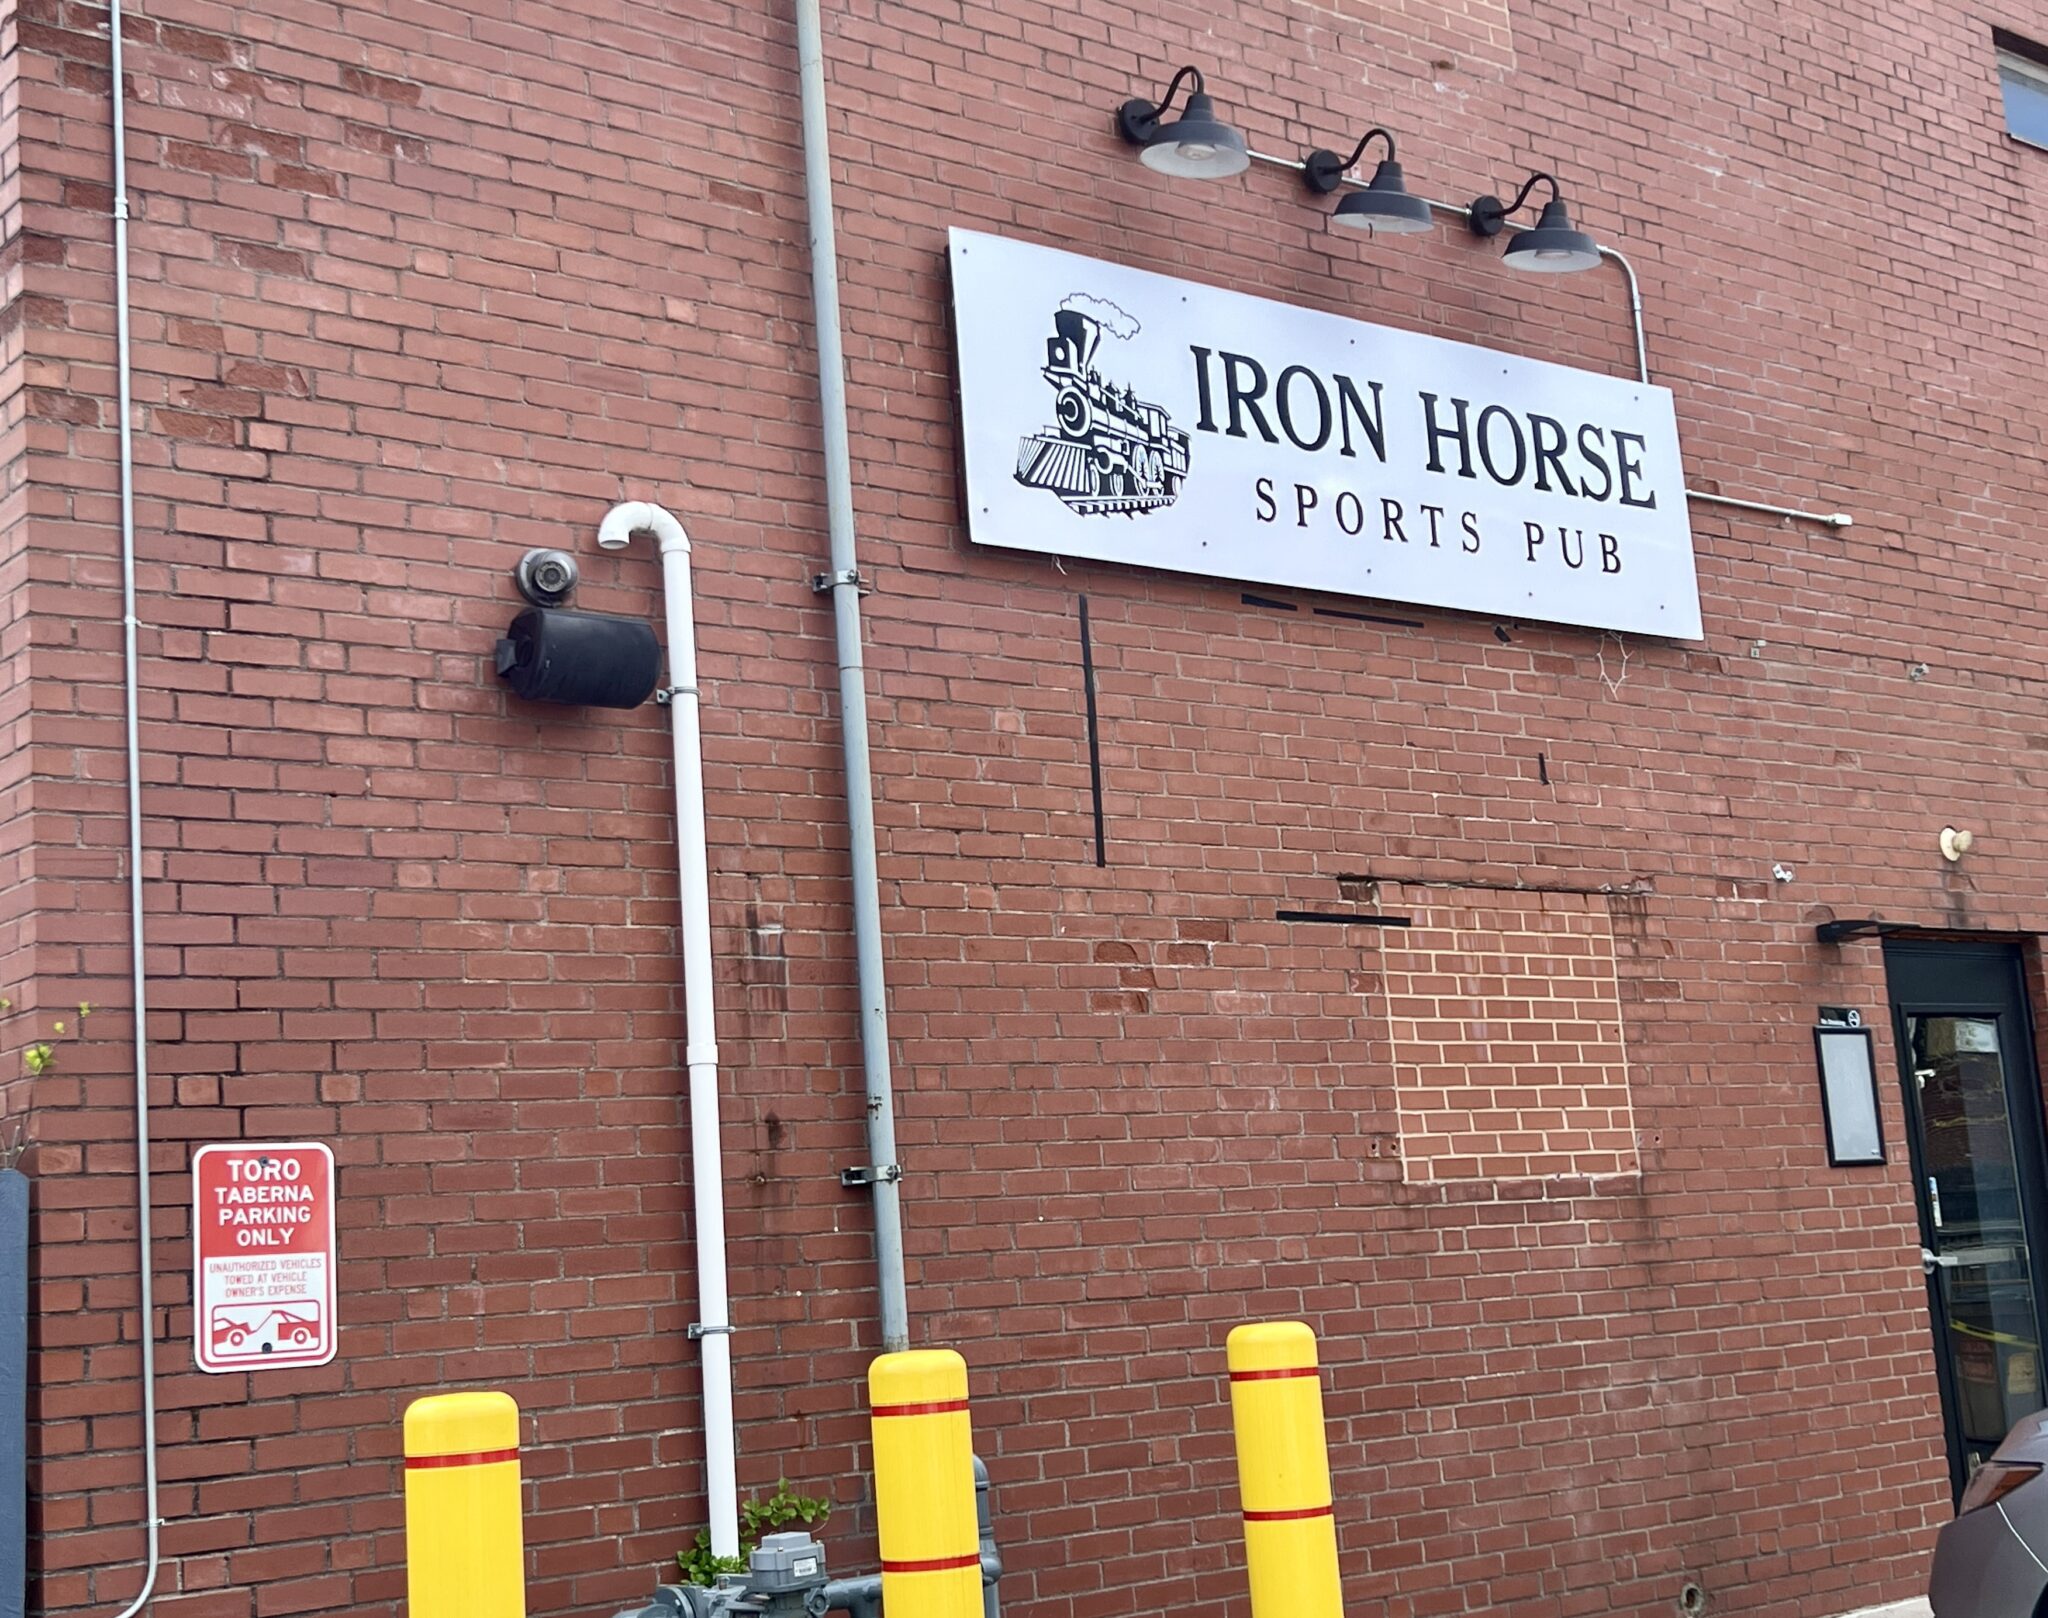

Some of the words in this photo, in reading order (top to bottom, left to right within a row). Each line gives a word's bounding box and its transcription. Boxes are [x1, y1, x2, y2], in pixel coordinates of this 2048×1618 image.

[1190, 344, 1387, 464] IRON
[1418, 391, 1657, 510] HORSE
[1255, 477, 1481, 554] SPORTS
[1523, 521, 1622, 574] PUB
[226, 1158, 301, 1182] TORO
[214, 1185, 314, 1205] TABERNA
[218, 1205, 311, 1226] PARKING
[236, 1227, 295, 1247] ONLY
[209, 1260, 277, 1274] UNAUTHORIZED
[280, 1257, 322, 1270] VEHICLES
[224, 1274, 254, 1285] TOWED
[257, 1273, 269, 1283] AT
[271, 1270, 308, 1282] VEHICLE
[225, 1286, 265, 1298] OWNER'S
[268, 1283, 308, 1297] EXPENSE
